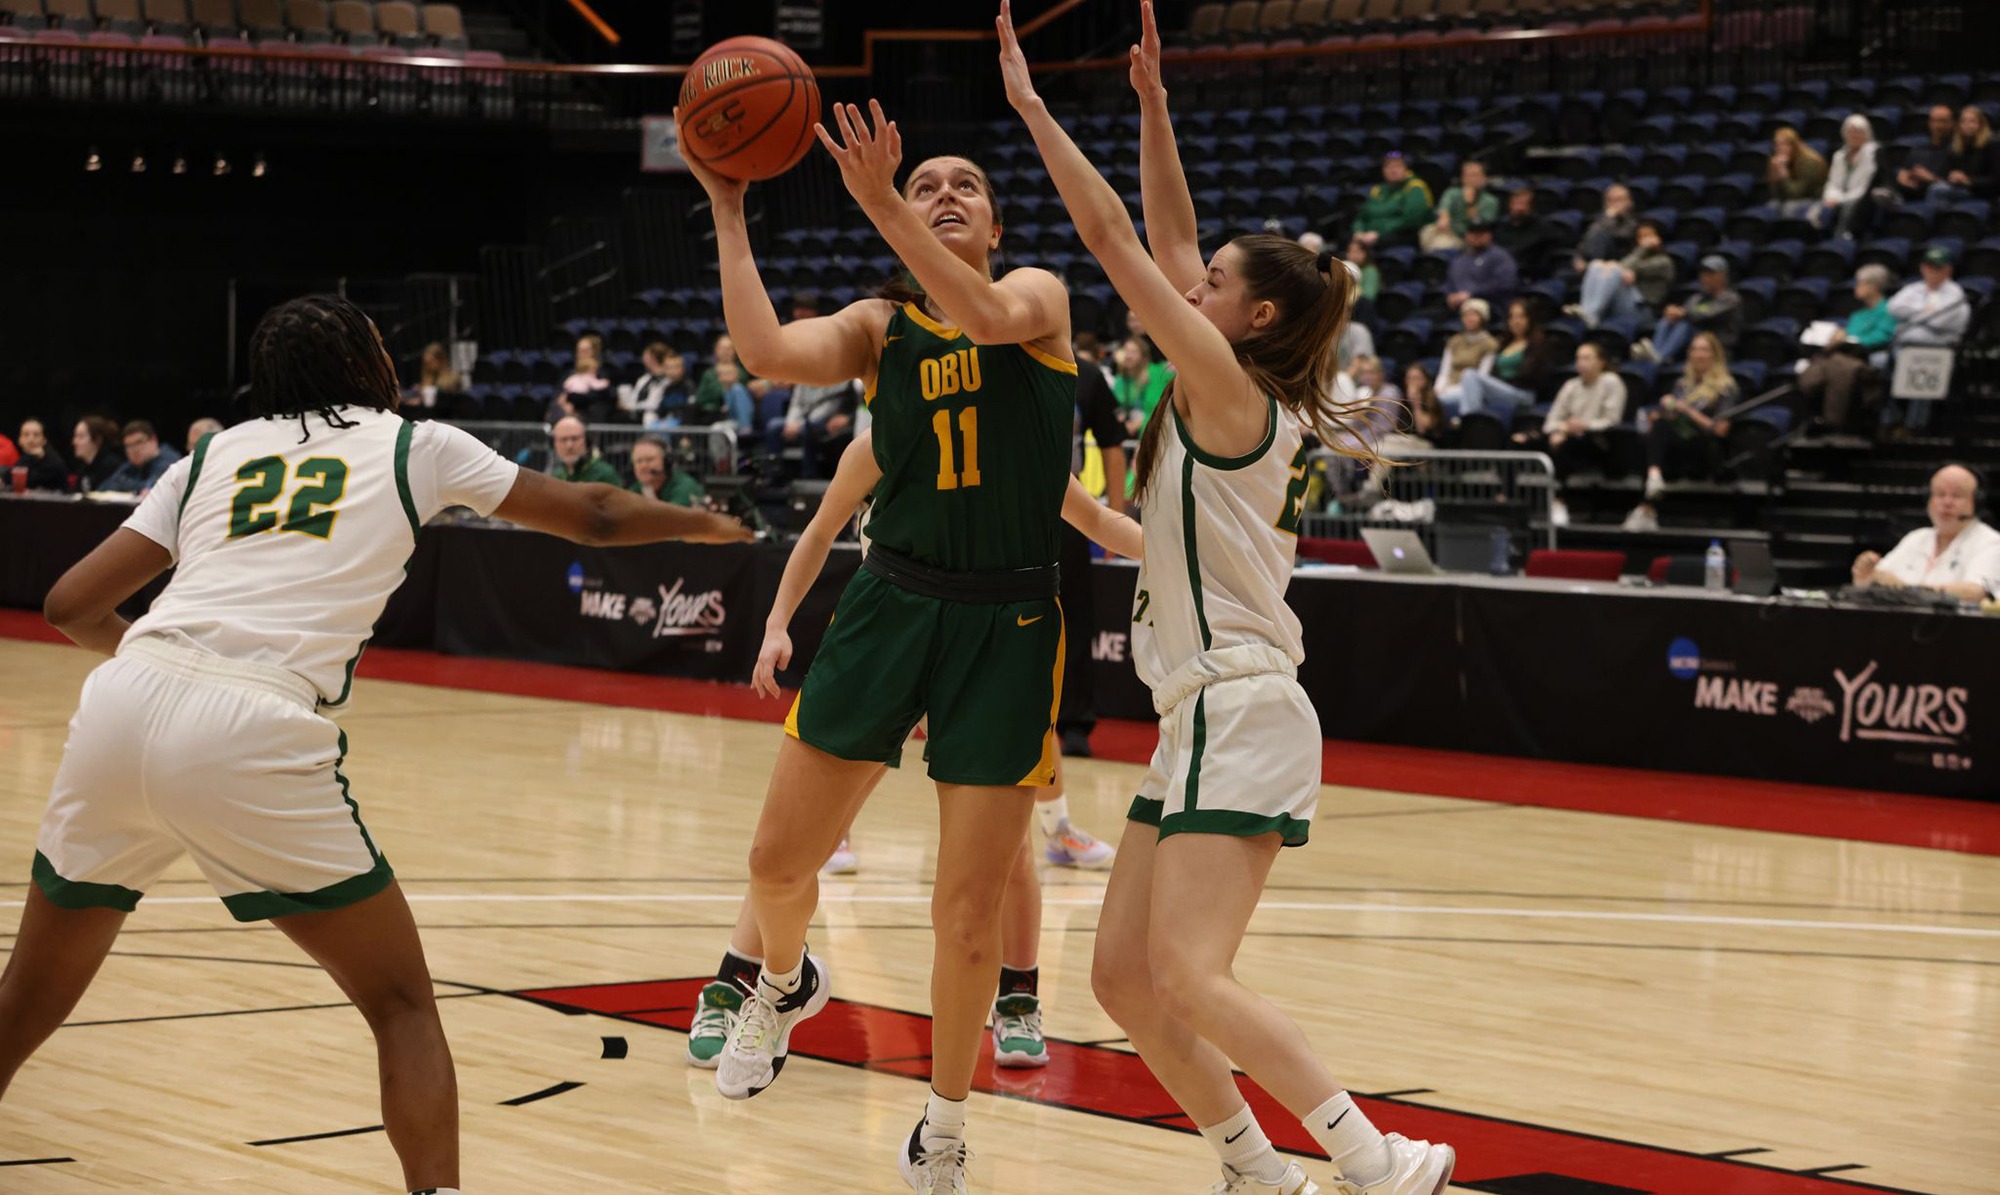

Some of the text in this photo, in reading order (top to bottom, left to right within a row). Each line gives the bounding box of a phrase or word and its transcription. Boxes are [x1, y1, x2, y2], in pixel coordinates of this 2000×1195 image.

[920, 346, 982, 401] OBU
[932, 406, 981, 490] 11
[224, 454, 350, 541] 22
[580, 590, 626, 620] MAKE
[1694, 660, 1968, 742] MAKE YOURS
